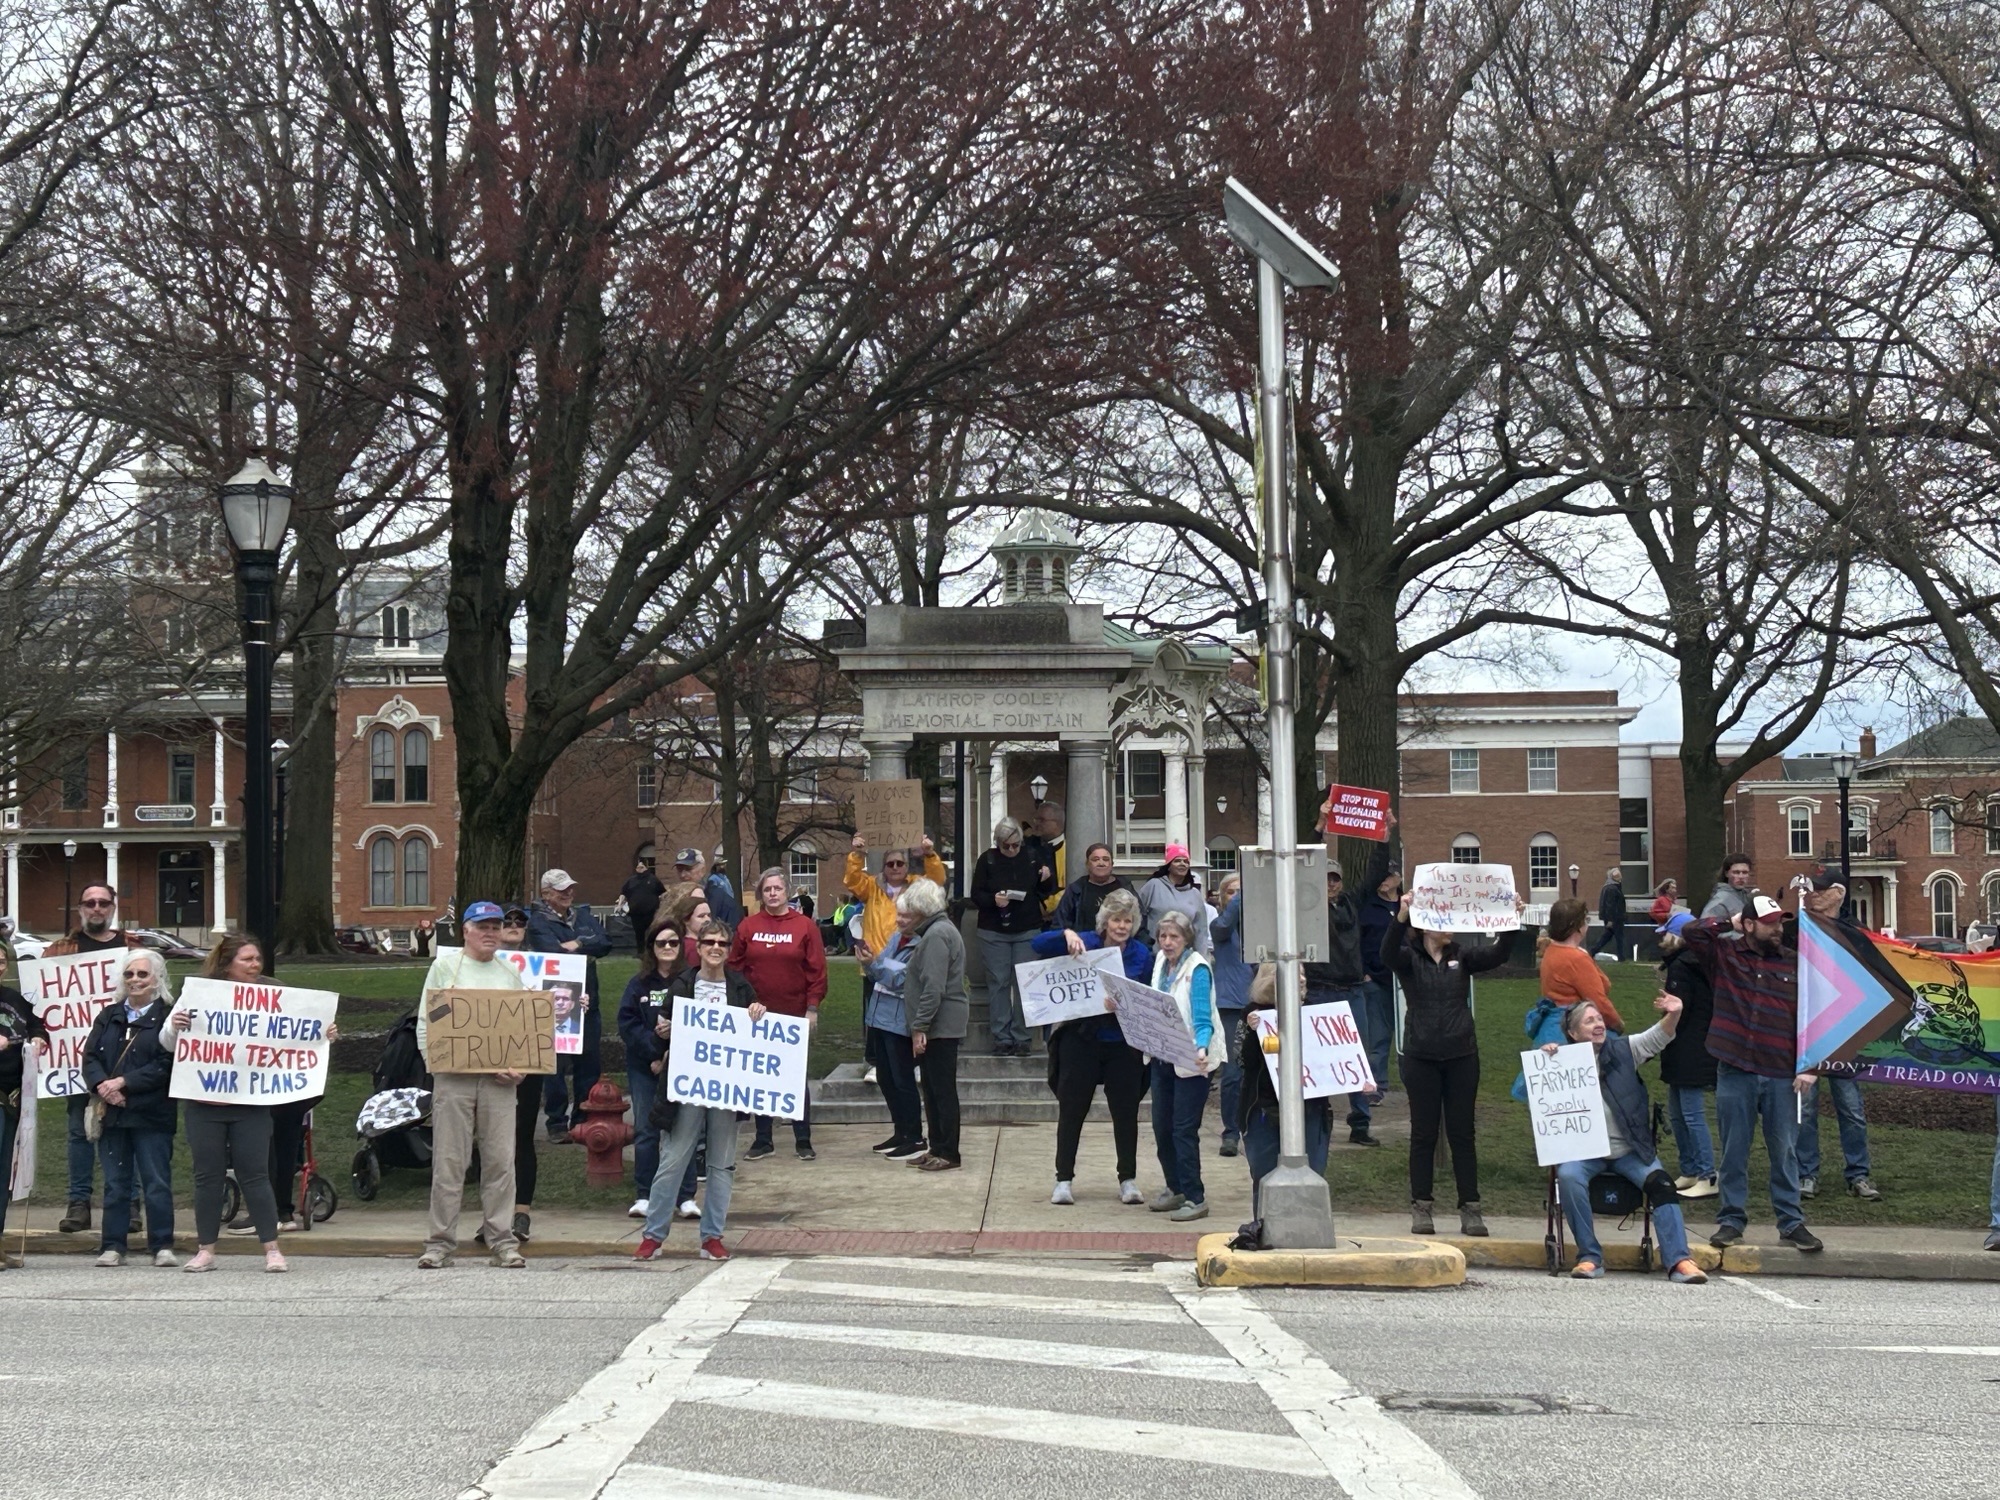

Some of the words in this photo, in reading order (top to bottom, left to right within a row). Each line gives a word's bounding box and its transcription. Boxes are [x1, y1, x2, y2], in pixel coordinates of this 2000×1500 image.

[901, 692, 985, 708] LATHROP
[993, 692, 1066, 708] COOLEY
[889, 713, 985, 729] MEMORIAL
[993, 713, 1083, 728] FOUNTAIN
[862, 787, 879, 801] NO
[884, 786, 912, 801] ONE
[1341, 794, 1361, 804] STOP
[1362, 797, 1379, 807] THE
[865, 810, 918, 826] ELECTED
[40, 959, 117, 999] HATE
[1045, 965, 1098, 985] HANDS
[233, 985, 283, 1014] HONK
[1049, 980, 1096, 1004] OFF
[266, 1016, 322, 1041] NEVER
[450, 997, 553, 1032] DUMP
[683, 1005, 736, 1034] IKEA
[752, 1019, 800, 1045] HAS
[1310, 1014, 1358, 1047] KING
[177, 1038, 236, 1064] DRUNK
[245, 1044, 318, 1071] TEXTED
[442, 1033, 554, 1069] TRUMP
[694, 1040, 781, 1077] BETTER
[197, 1069, 238, 1094] WAR
[250, 1071, 308, 1095] PLANS
[1529, 1066, 1597, 1095] FARMERS
[1817, 1060, 1878, 1076] DON'T
[1884, 1065, 1946, 1083] TREAD
[1952, 1071, 1979, 1085] ON
[1983, 1073, 2000, 1087] A
[674, 1074, 796, 1114] CABINETS
